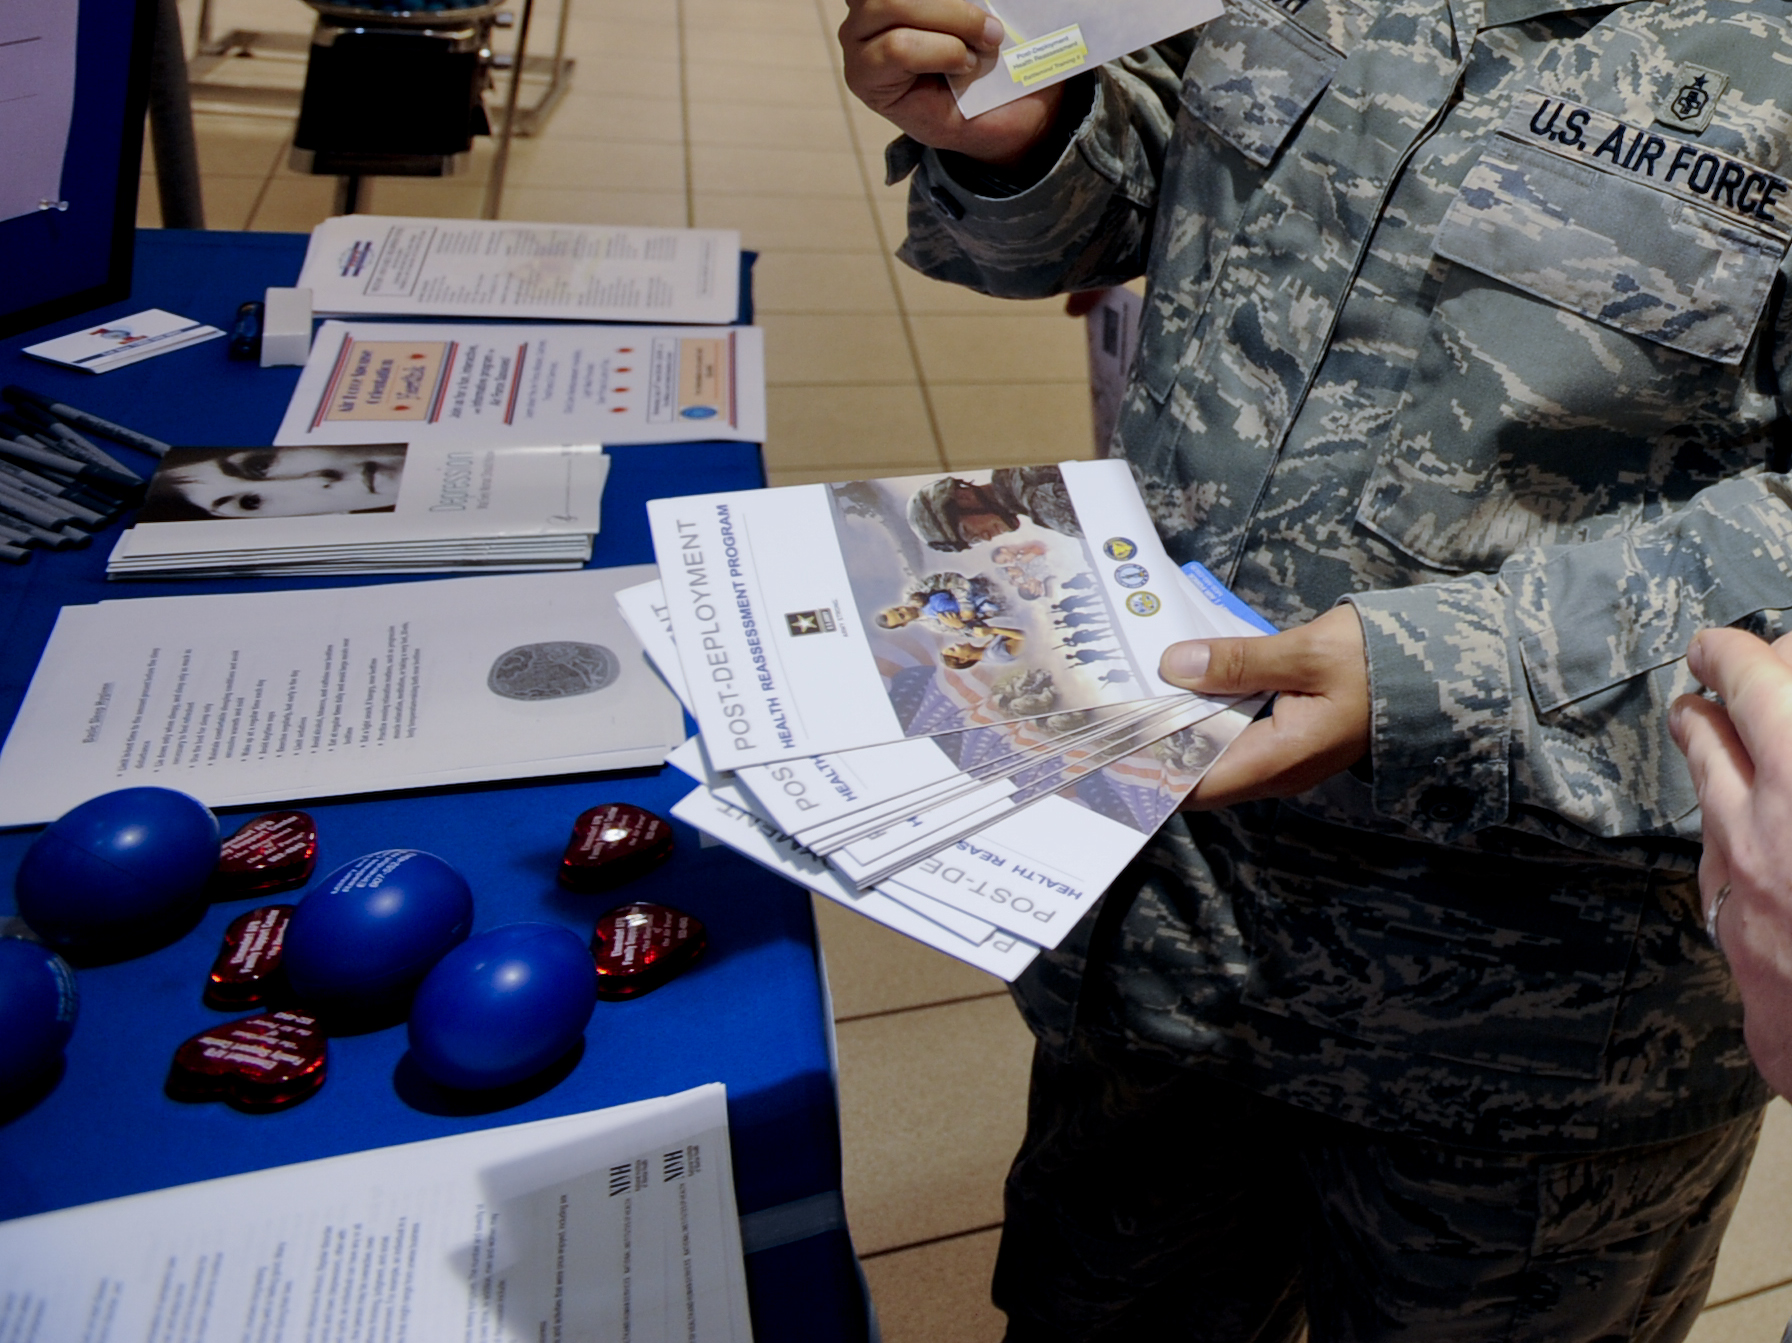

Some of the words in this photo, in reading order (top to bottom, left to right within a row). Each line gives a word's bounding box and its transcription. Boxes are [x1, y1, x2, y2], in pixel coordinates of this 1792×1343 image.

[1016, 35, 1069, 60] Post-Deployment
[1529, 99, 1591, 152] U.S.
[1592, 124, 1667, 176] AIR
[1664, 145, 1788, 222] FORCE
[429, 451, 475, 512] Depression
[716, 504, 743, 577] PROGRAM
[676, 519, 757, 751] POST-DEPLOYMENT
[732, 581, 776, 691] REASSESSMENT
[766, 697, 796, 749] HEALTH
[767, 763, 820, 812] POS
[1011, 864, 1084, 900] HEALTH
